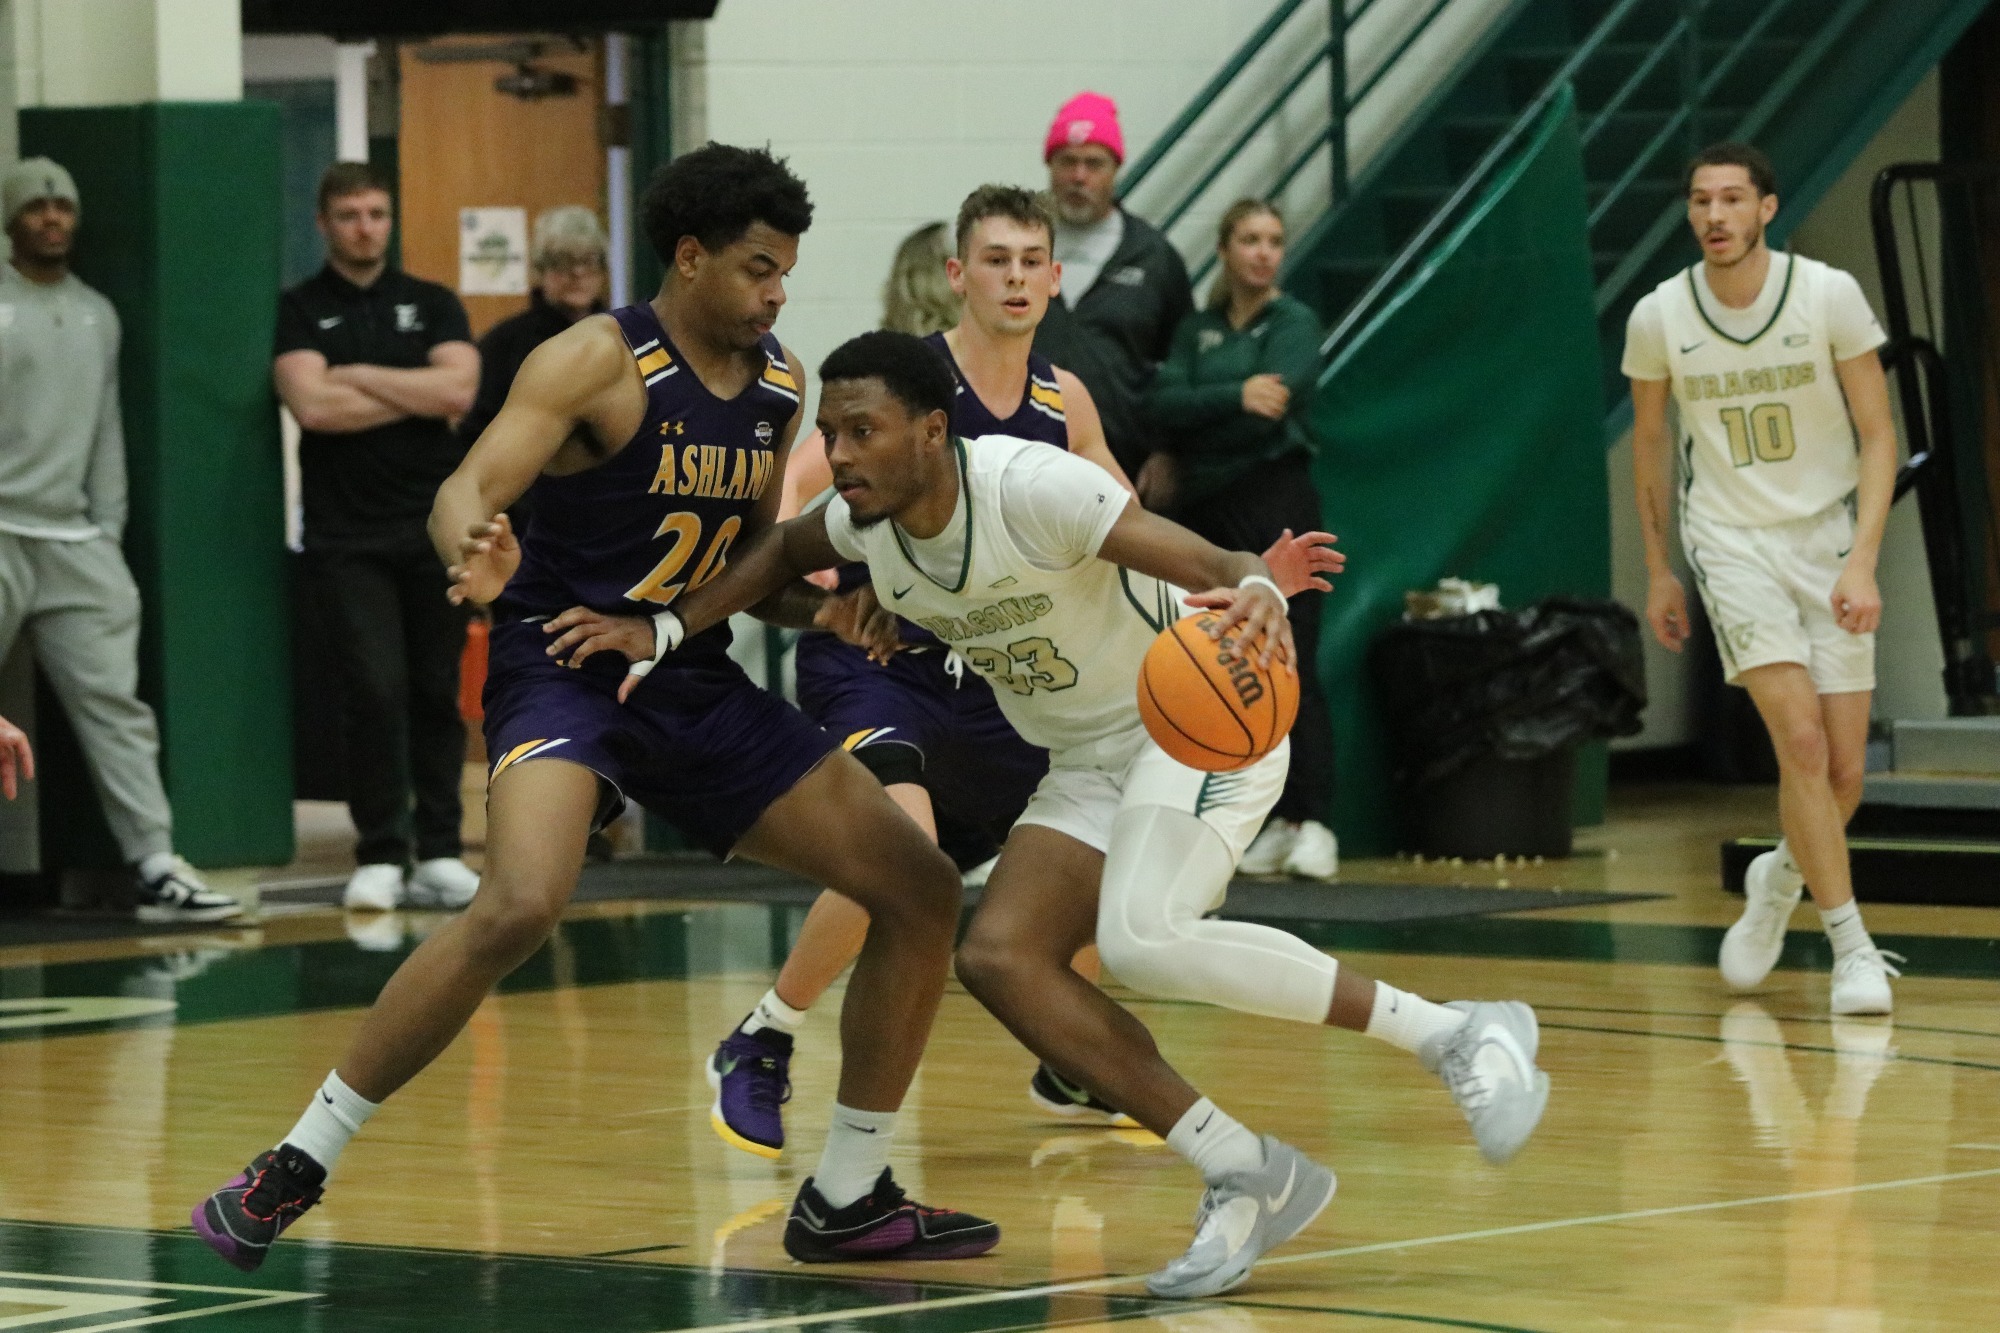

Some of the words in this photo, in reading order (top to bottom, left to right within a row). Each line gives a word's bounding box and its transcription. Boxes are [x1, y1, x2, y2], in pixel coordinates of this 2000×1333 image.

[1683, 361, 1817, 402] DRAGONS
[1719, 402, 1796, 468] 10
[623, 511, 742, 606] 20
[916, 592, 1054, 641] DRAGONS
